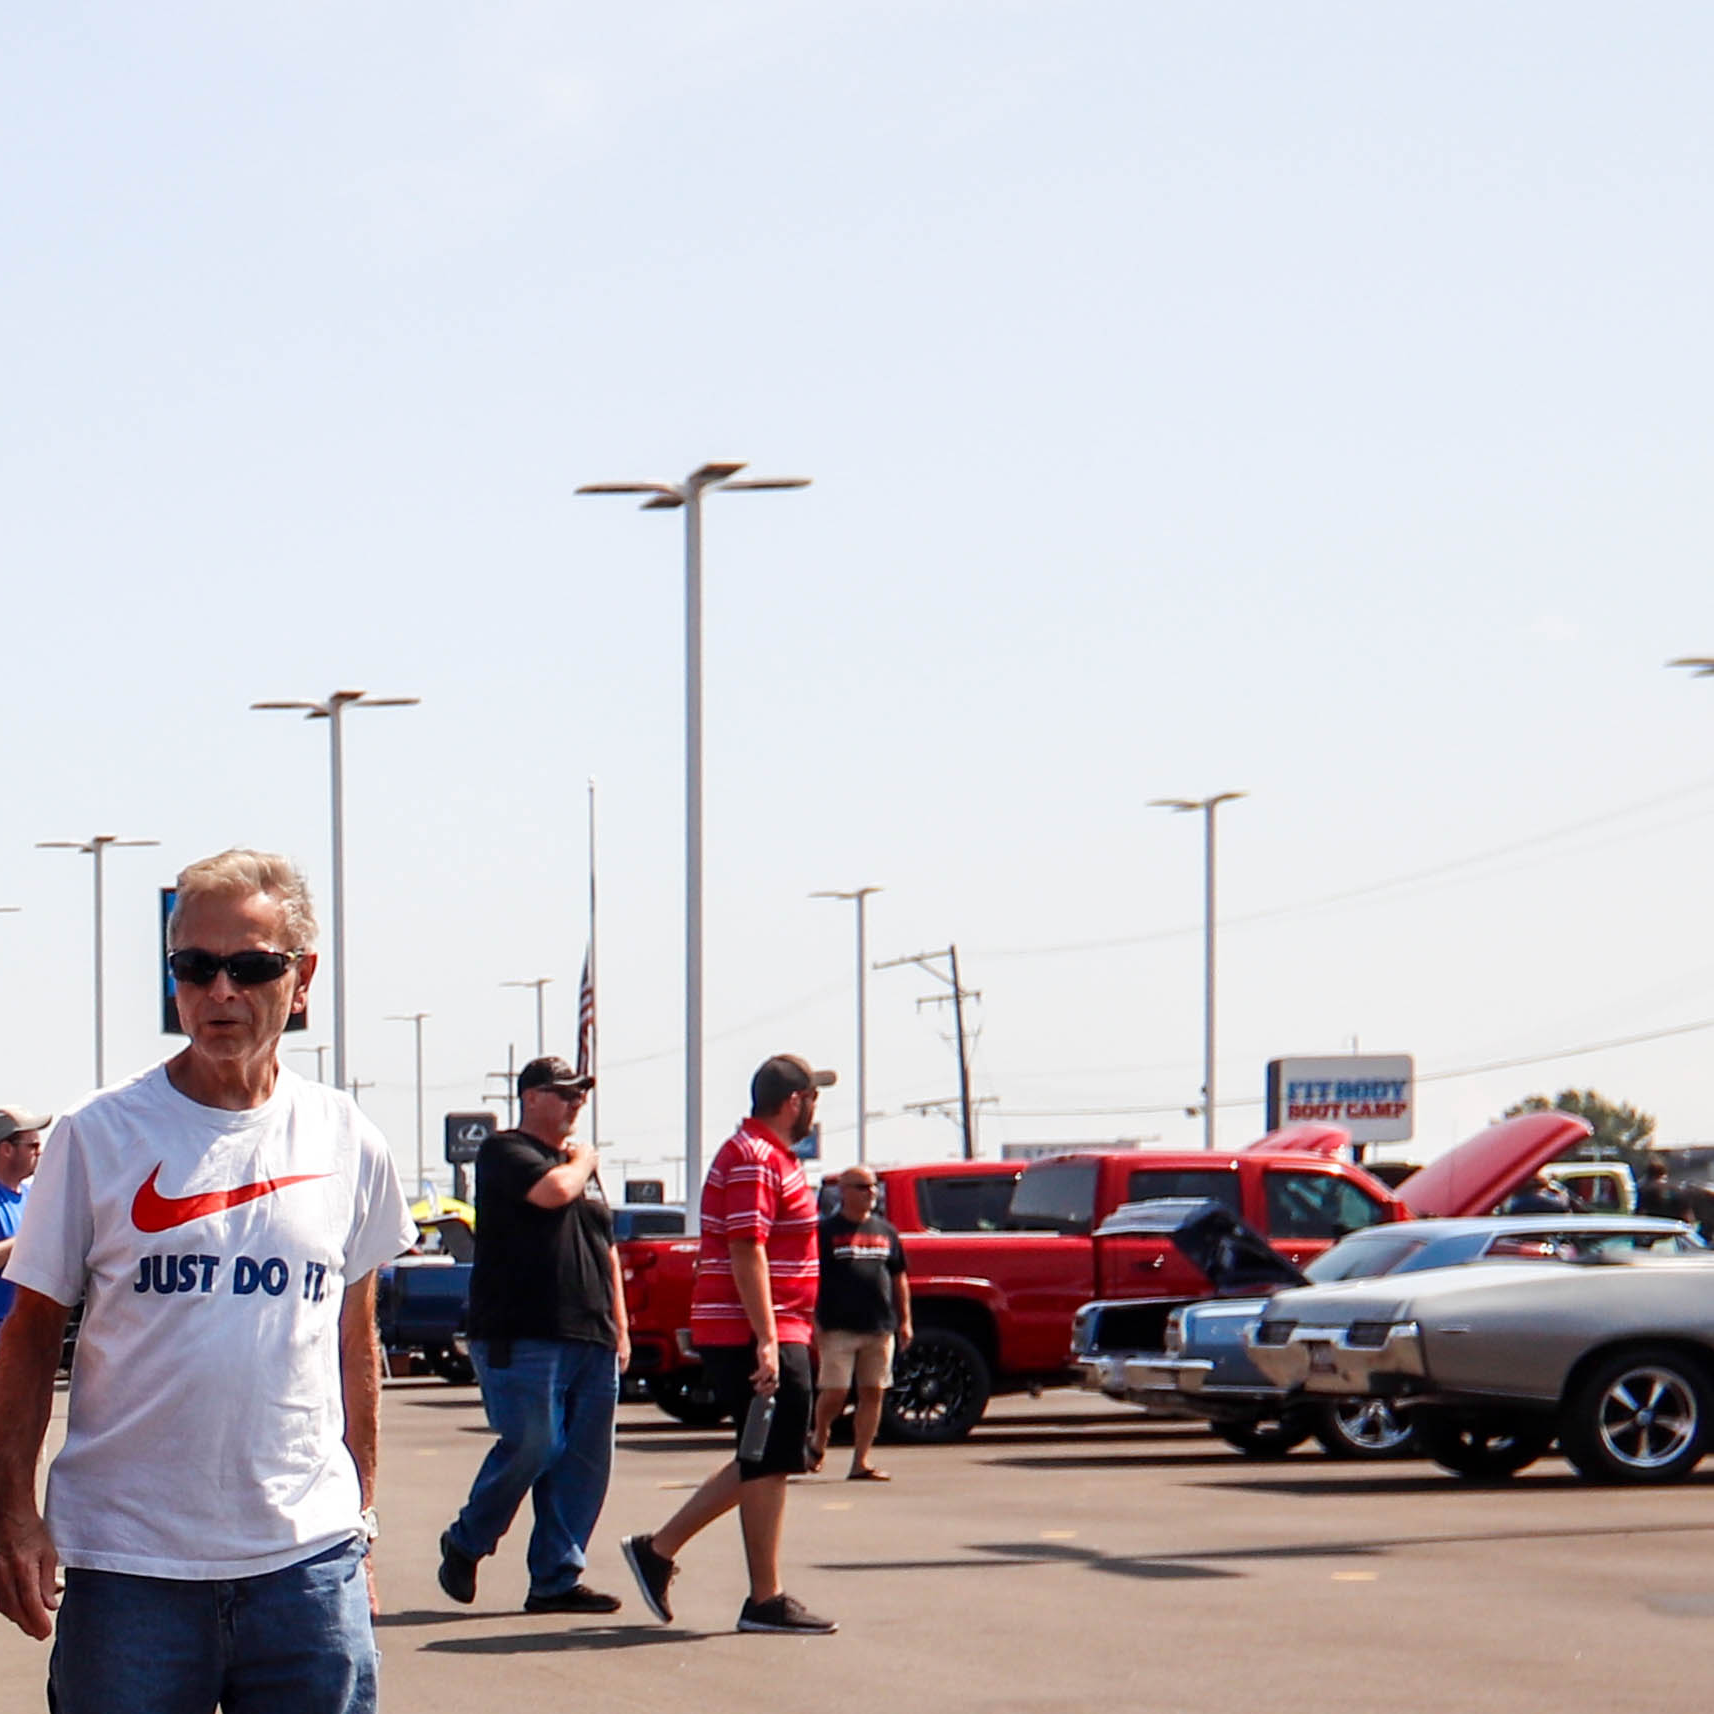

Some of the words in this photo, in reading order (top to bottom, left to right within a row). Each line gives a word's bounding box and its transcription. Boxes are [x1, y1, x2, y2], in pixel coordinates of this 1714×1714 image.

[1287, 1081, 1332, 1100] FIT
[1288, 1103, 1340, 1119] BOOT
[1346, 1102, 1407, 1118] CAMP
[134, 1254, 220, 1294] JUST
[233, 1255, 289, 1296] DO
